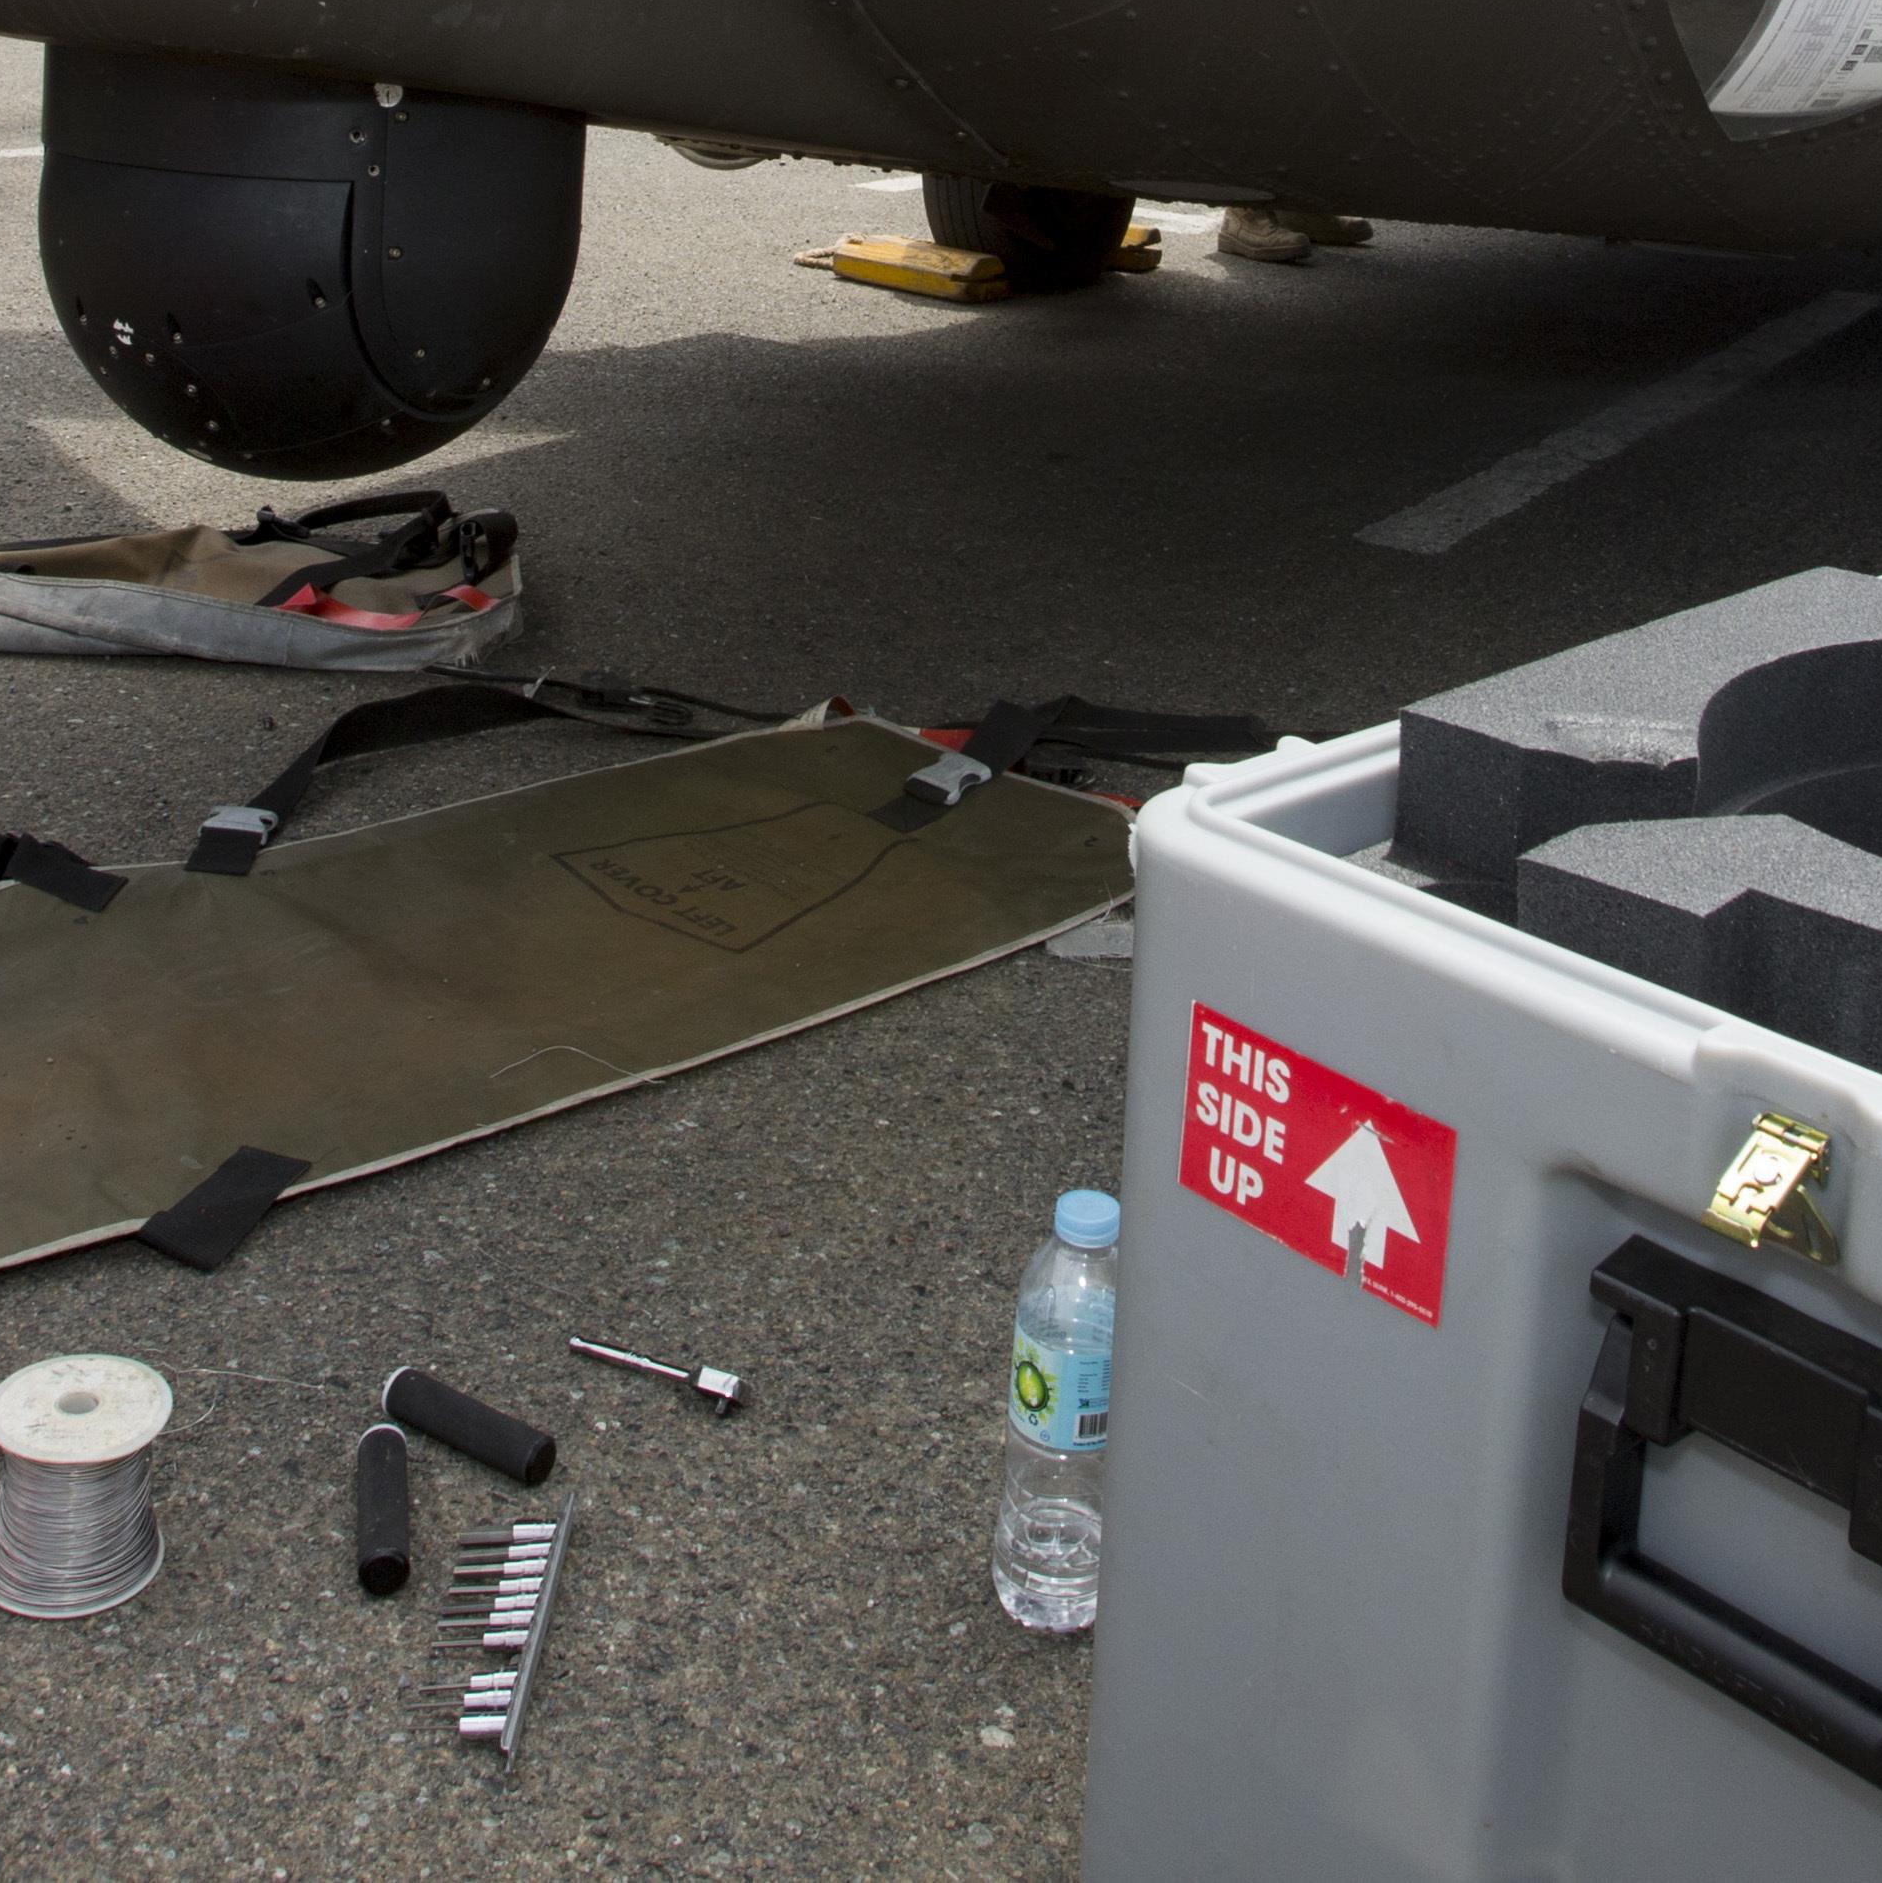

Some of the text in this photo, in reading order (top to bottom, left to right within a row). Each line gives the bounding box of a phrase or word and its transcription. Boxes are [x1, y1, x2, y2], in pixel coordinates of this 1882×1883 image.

[1202, 1021, 1291, 1104] THIS
[1196, 1081, 1286, 1165] SIDE
[1209, 1146, 1264, 1206] UP
